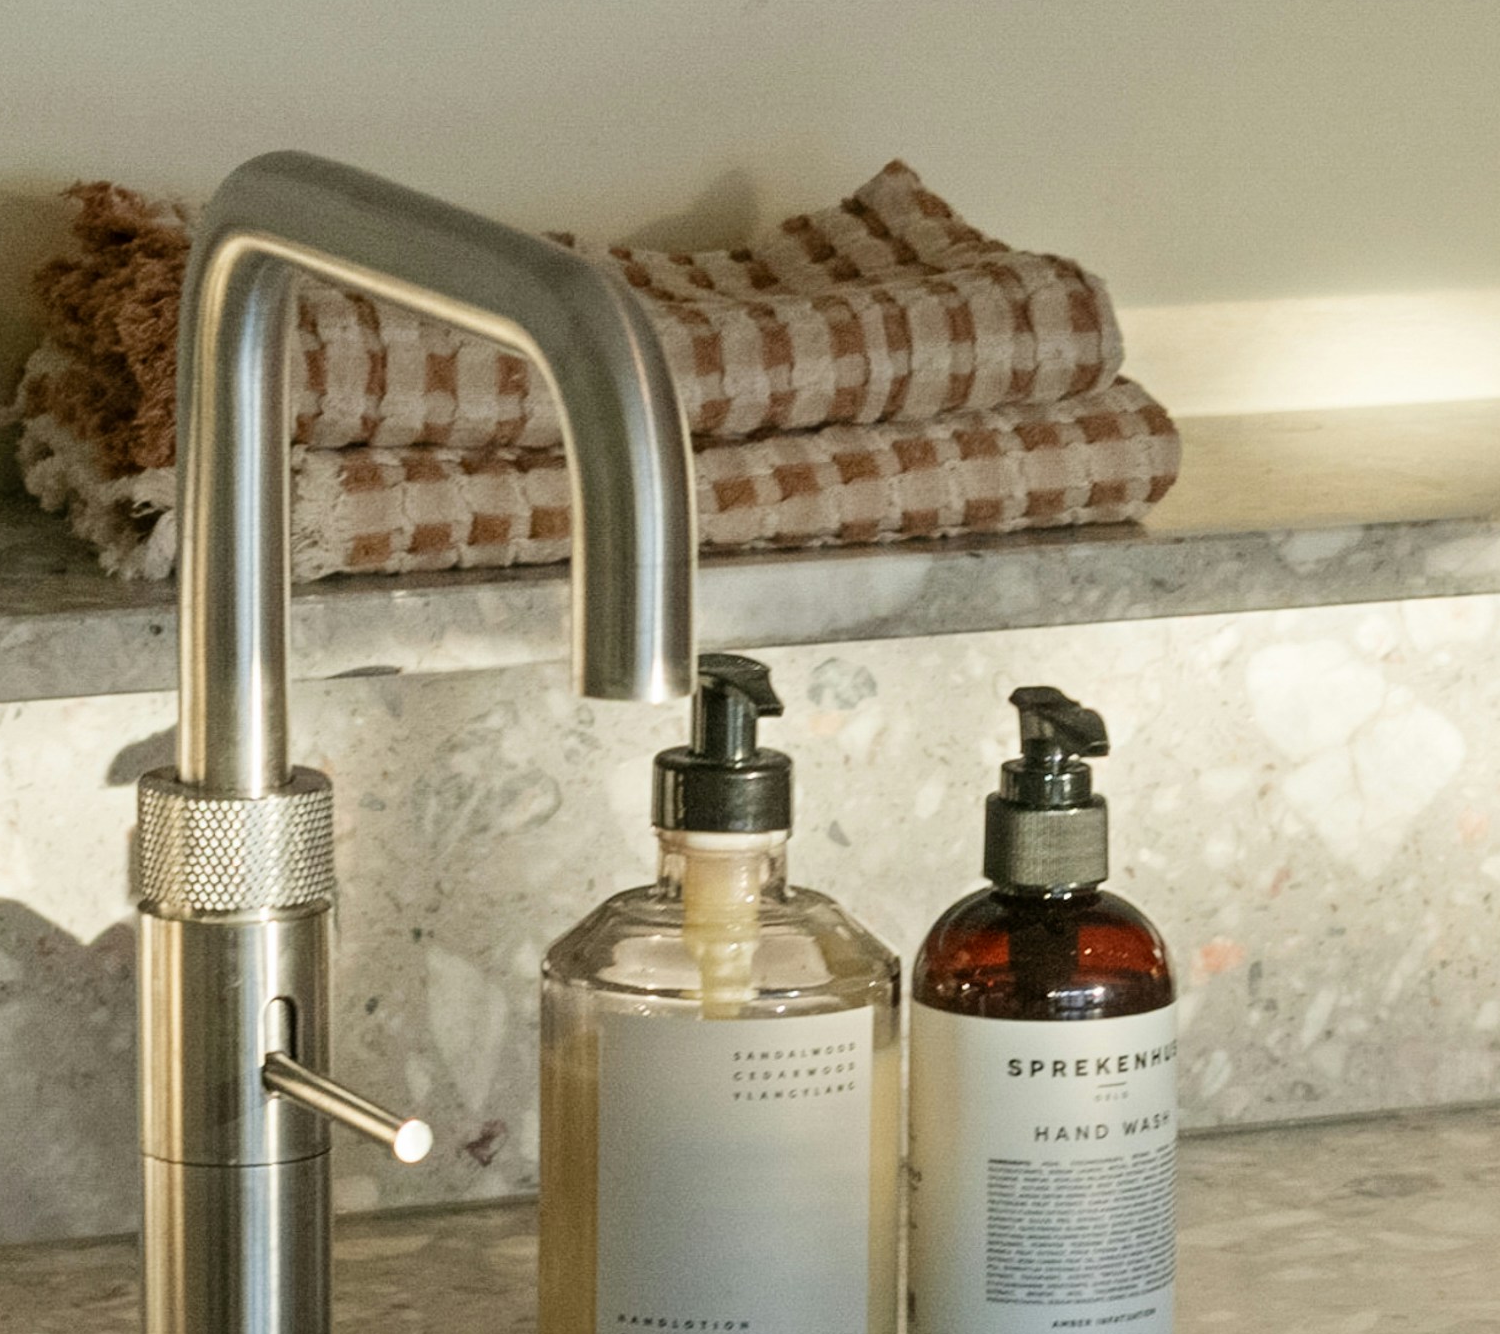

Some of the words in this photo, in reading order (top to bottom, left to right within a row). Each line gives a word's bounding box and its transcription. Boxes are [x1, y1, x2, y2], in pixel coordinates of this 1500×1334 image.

[731, 1041, 855, 1062] SANDALWOOD
[731, 1061, 855, 1082] CEDARWOOD
[1033, 1123, 1109, 1142] HAND
[1121, 1109, 1171, 1136] WASH
[616, 1313, 749, 1331] HANDLOTION
